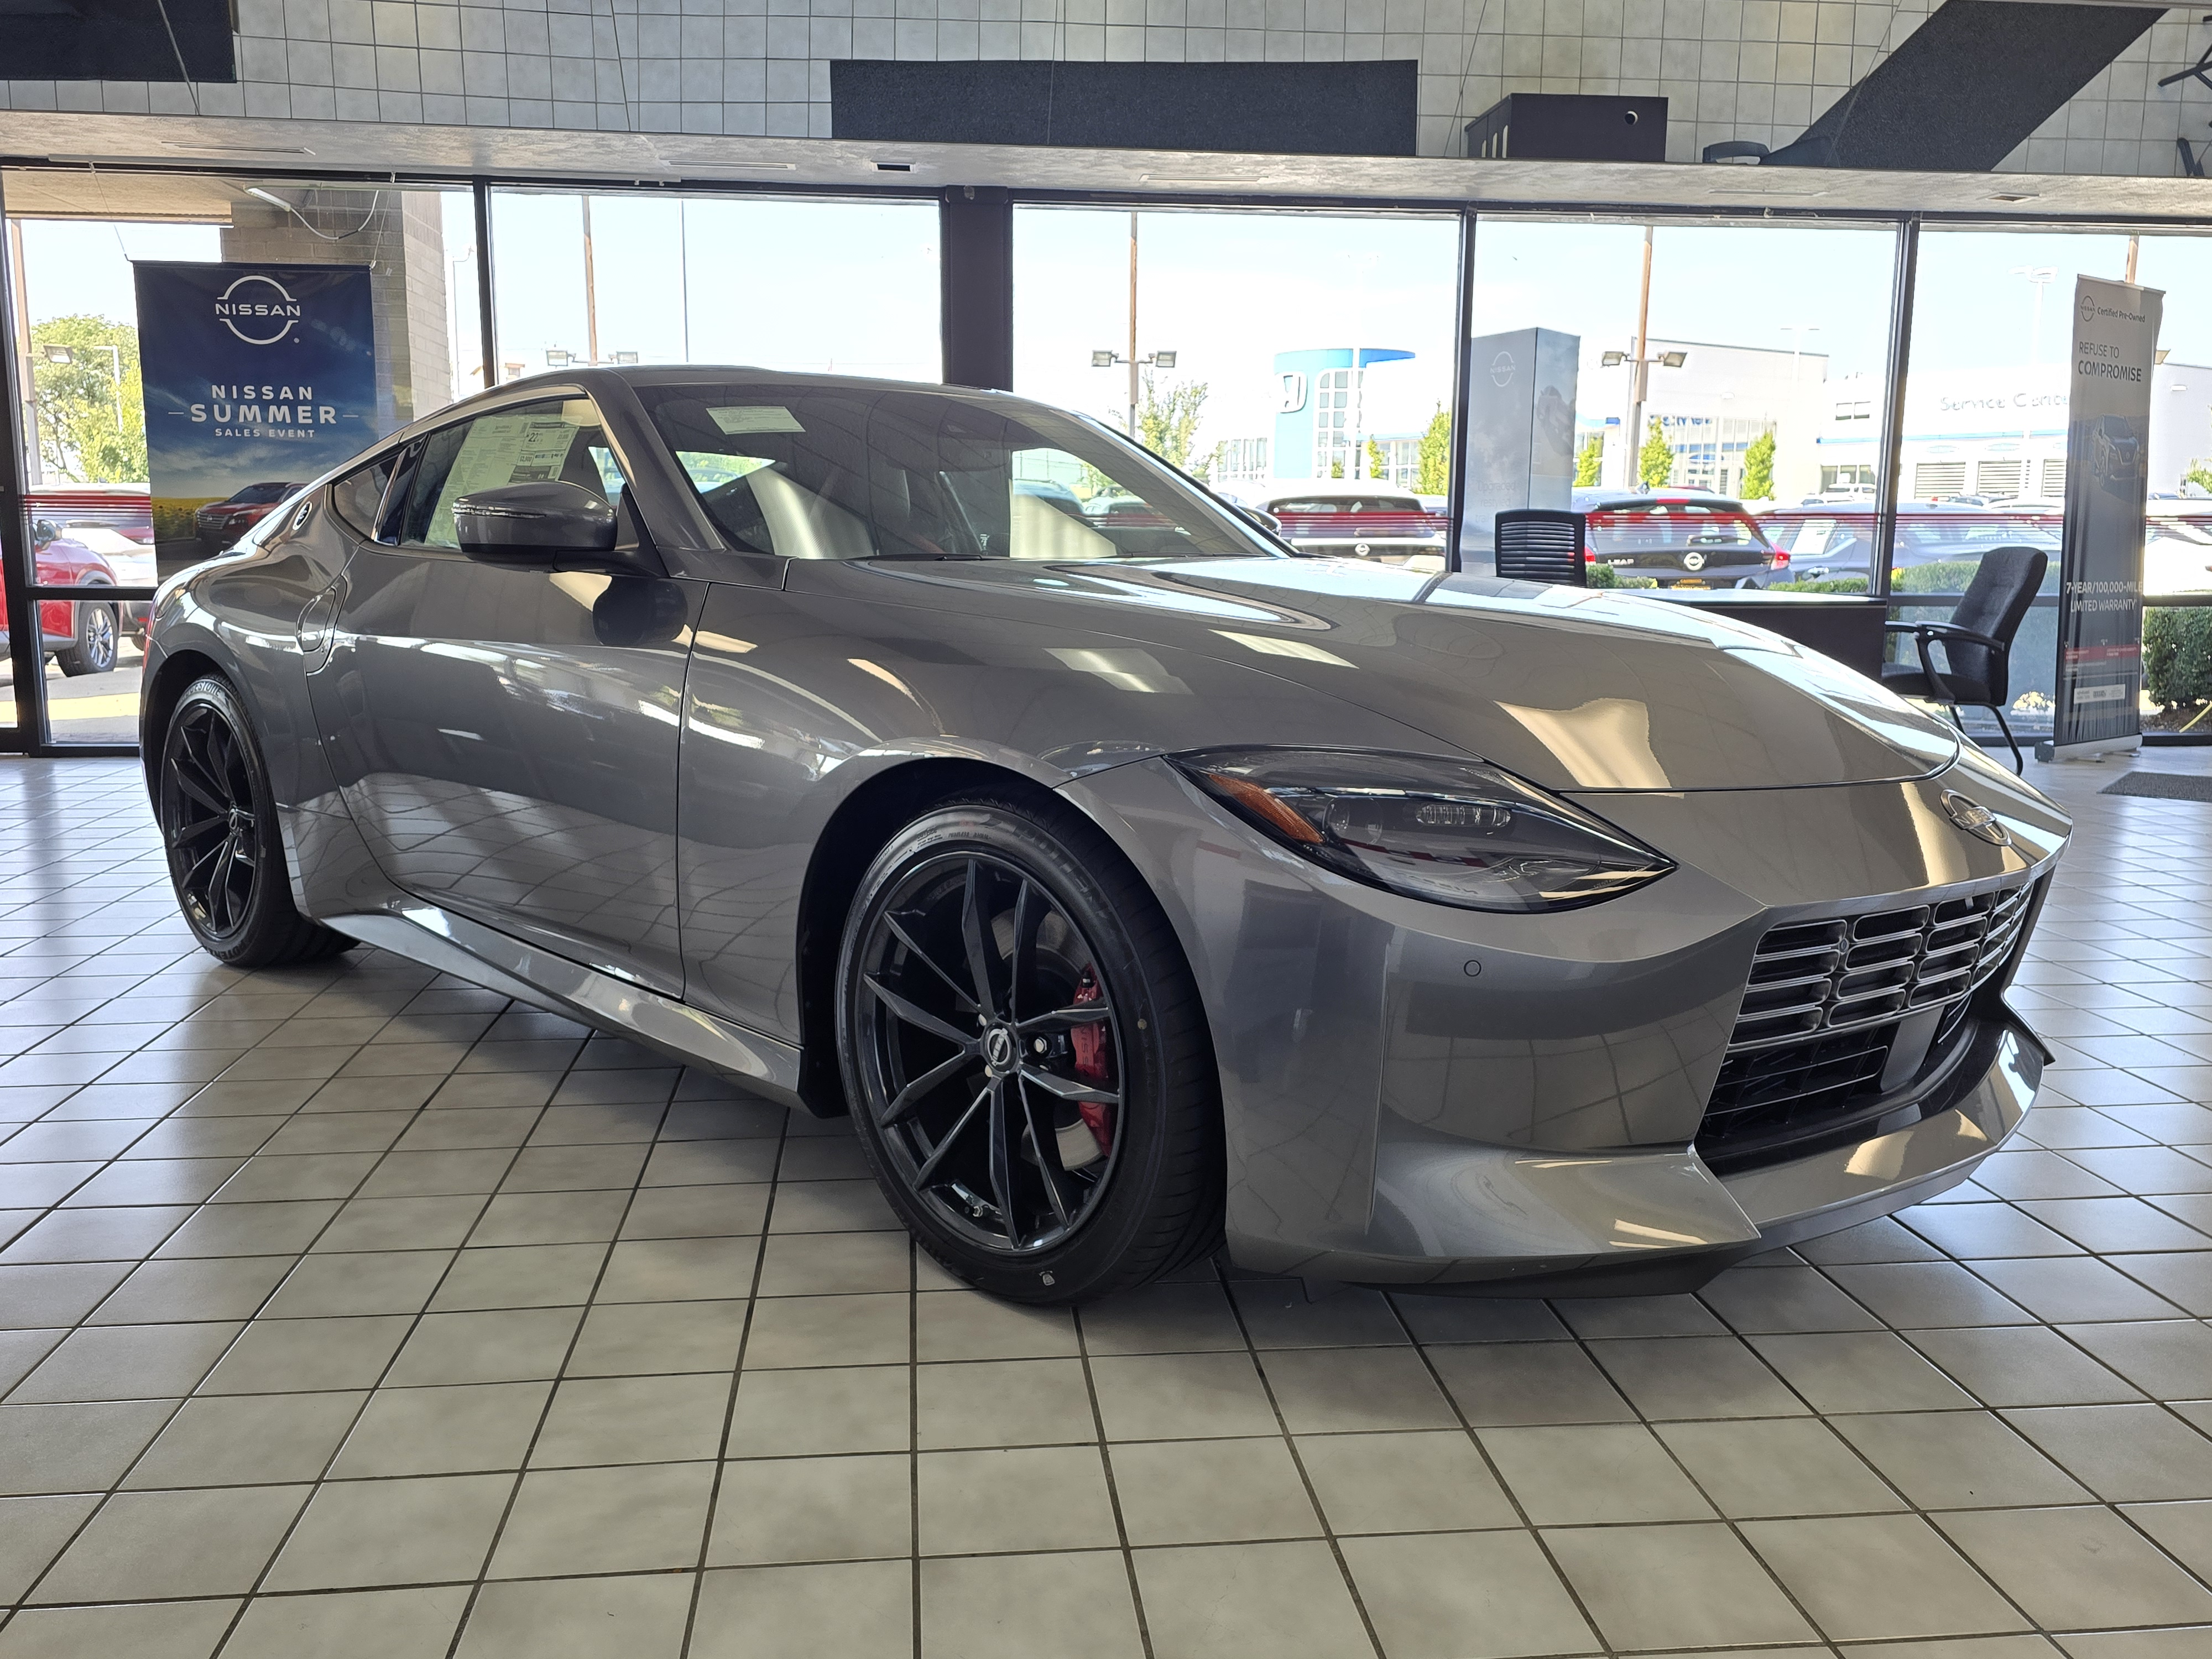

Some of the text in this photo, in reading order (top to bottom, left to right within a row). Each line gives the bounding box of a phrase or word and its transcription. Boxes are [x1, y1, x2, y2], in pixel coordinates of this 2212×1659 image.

[216, 304, 300, 316] NISSAN
[2098, 307, 2119, 318] Certified
[2119, 311, 2145, 322] Pre-Owned
[2079, 341, 2120, 359] REFUSE TO
[1490, 365, 1515, 373] NISSAN
[2078, 359, 2142, 382] COMPROMISE
[212, 385, 312, 400] NISSAN
[1940, 393, 2069, 411] Service Cente
[191, 404, 337, 424] SUMMER
[215, 428, 315, 438] SALES EVENT
[528, 432, 539, 442] 22
[2066, 581, 2142, 595] 7-YEAR/100,000-MILE
[2070, 599, 2097, 613] LIMITED
[992, 1027, 1008, 1067] NISSAN
